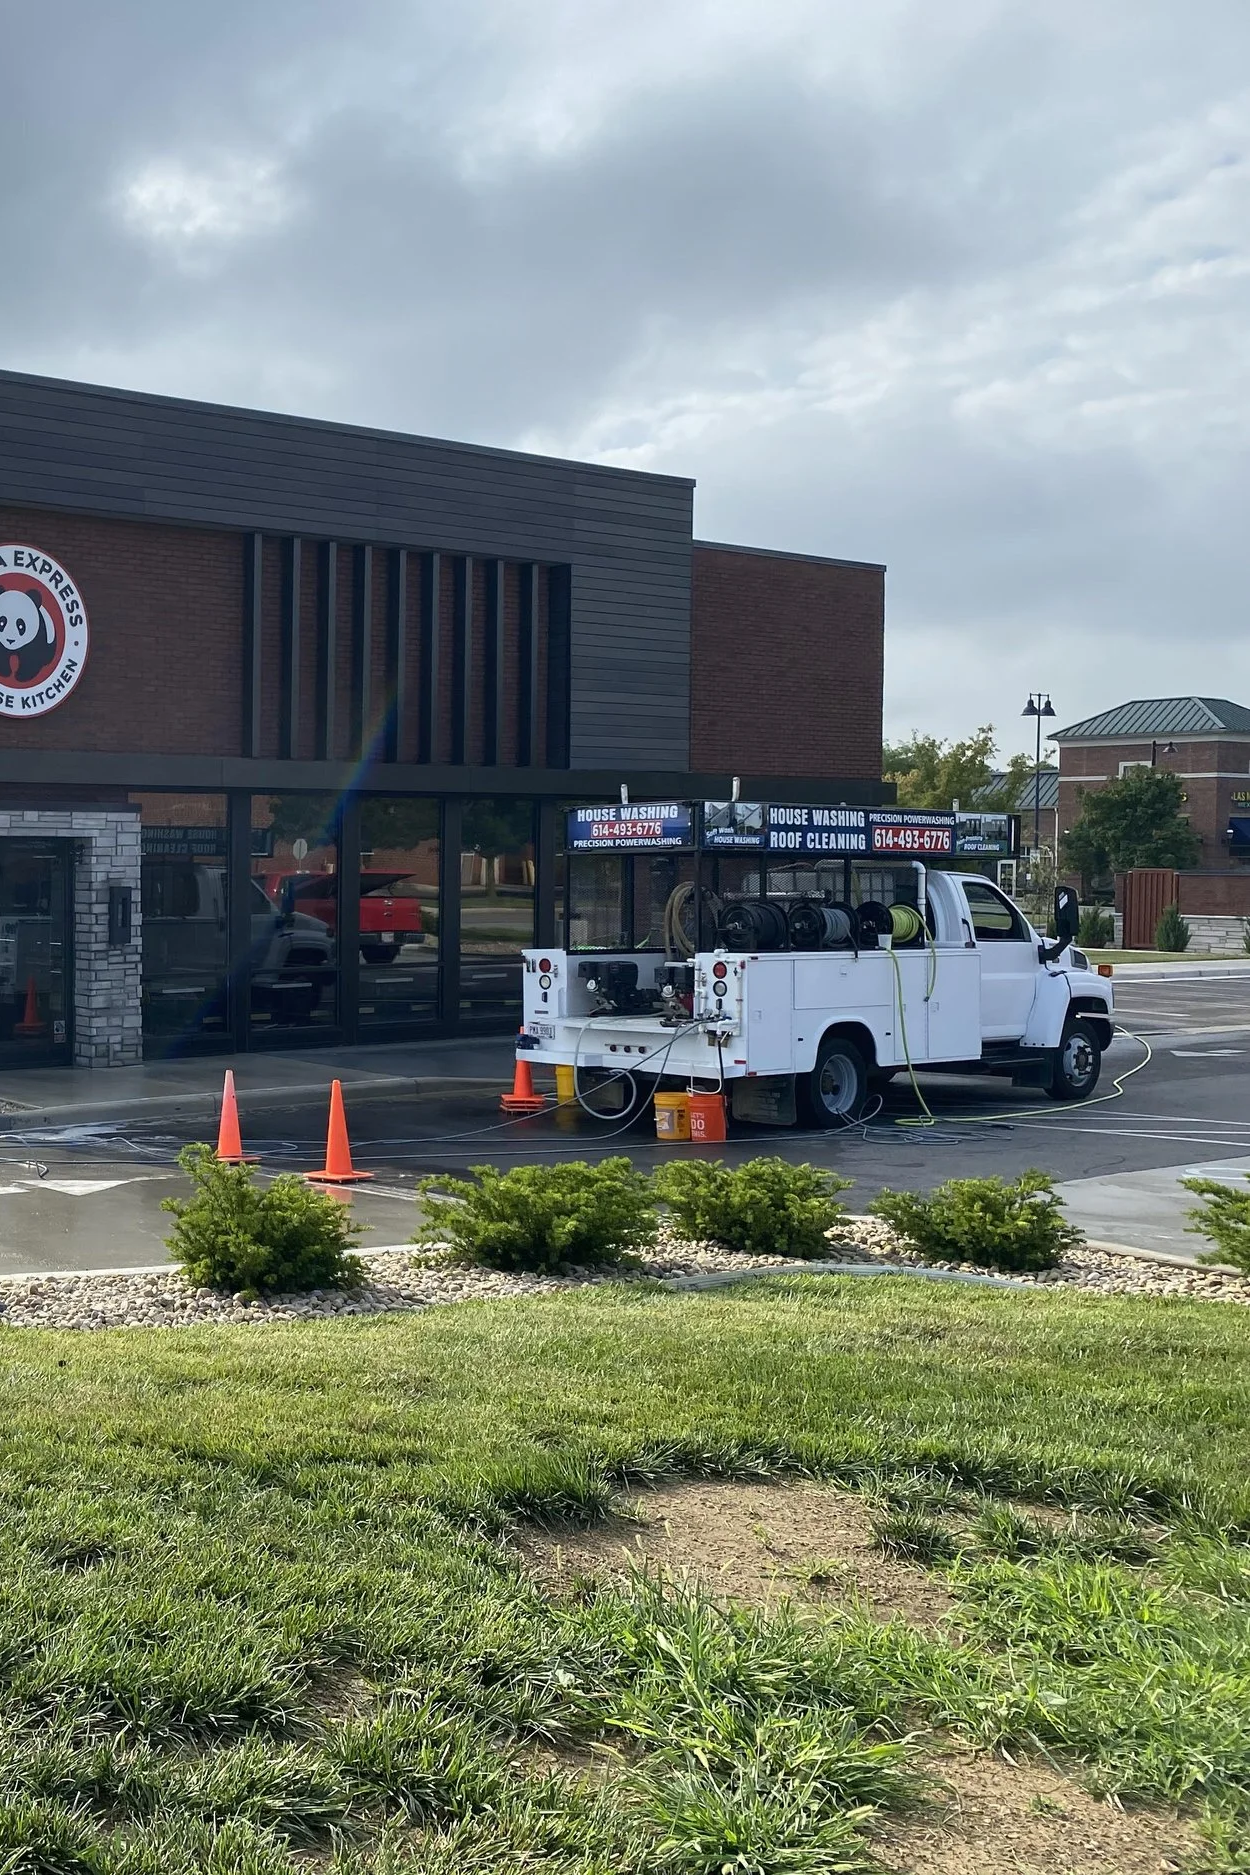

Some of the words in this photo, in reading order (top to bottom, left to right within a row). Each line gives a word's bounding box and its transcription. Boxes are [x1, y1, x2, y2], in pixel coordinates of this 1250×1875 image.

[14, 550, 83, 627] EXPRESS
[21, 658, 78, 709] KITCHEN
[577, 808, 616, 822] HOUSE
[620, 805, 678, 820] WASHING
[770, 808, 808, 826] HOUSE
[813, 810, 865, 828] WASHING
[869, 813, 902, 823] PRECISION
[904, 815, 954, 825] POWERWASHING
[592, 822, 661, 837] 614-493-6776
[574, 839, 614, 848] PRECISION
[616, 837, 682, 846] POWERWASHING
[770, 832, 802, 848] ROOF
[807, 833, 866, 850] CLEANING
[874, 829, 950, 850] 614-493-6776
